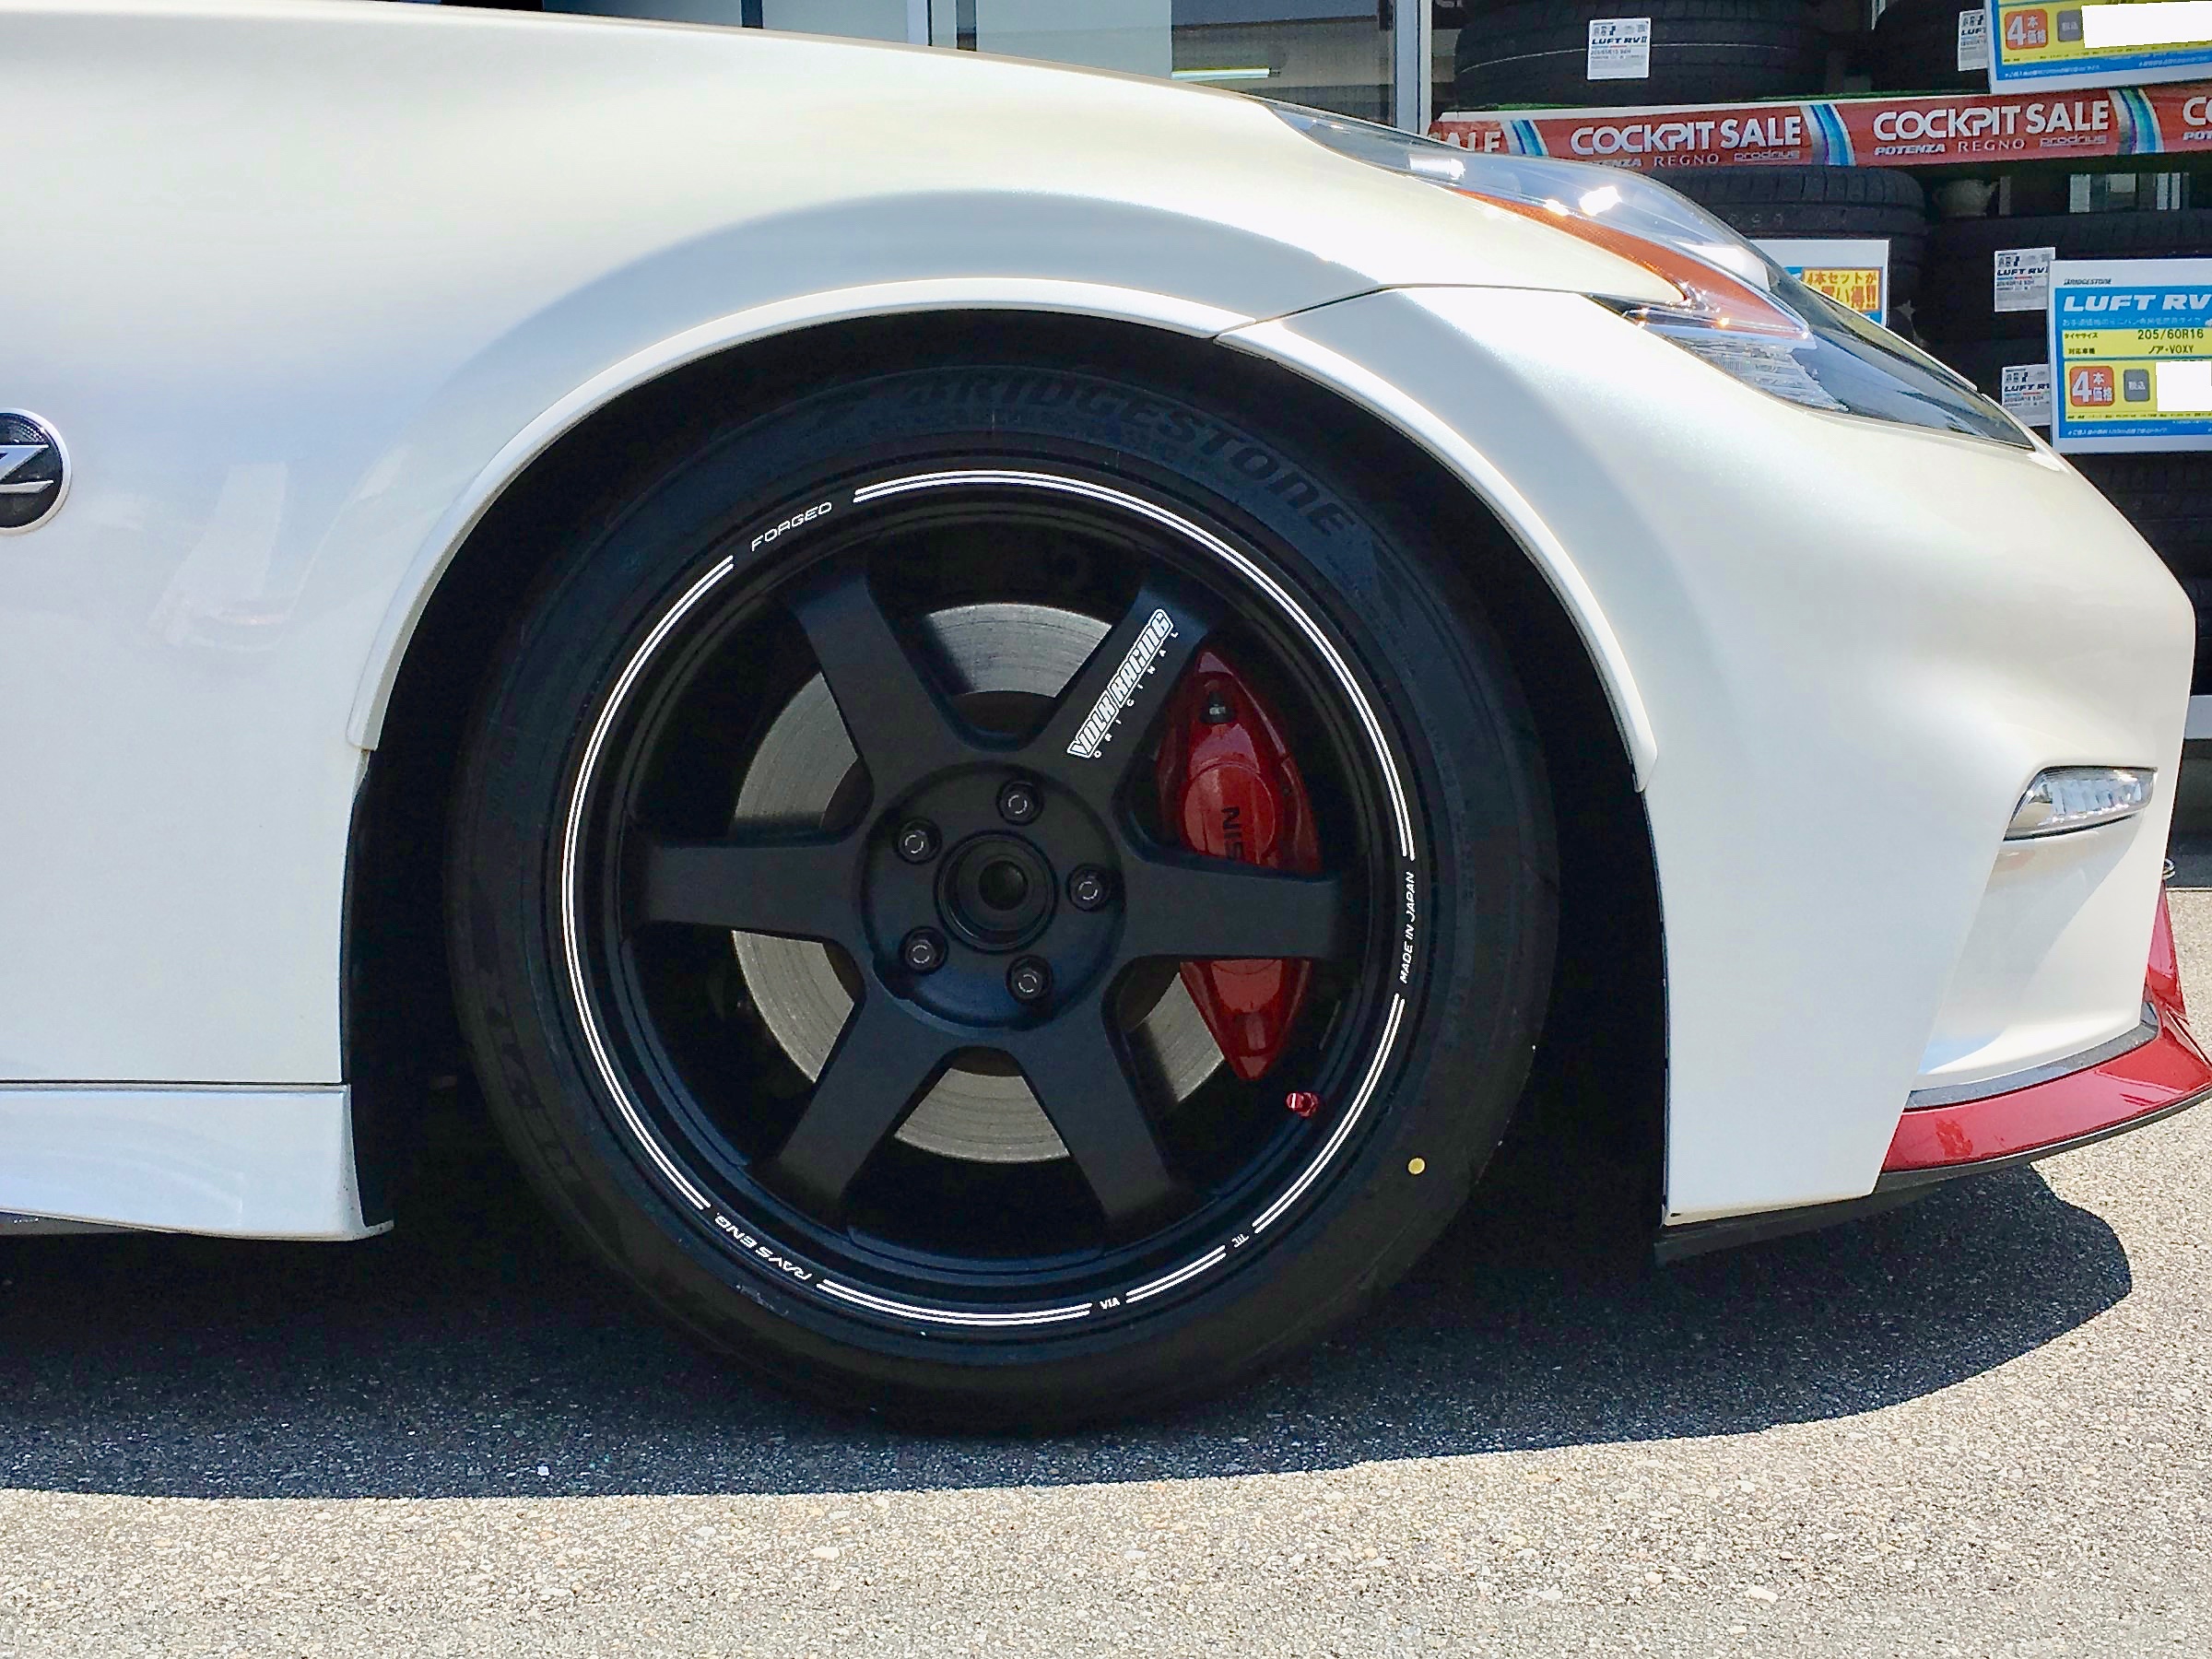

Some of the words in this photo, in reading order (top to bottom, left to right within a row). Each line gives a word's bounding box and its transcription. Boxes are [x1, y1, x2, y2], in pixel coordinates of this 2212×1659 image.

[1873, 104, 2022, 141] COCKPIT
[2025, 100, 2110, 135] SALE
[1571, 121, 1716, 156] COCKPIT
[1719, 115, 1802, 149] SALE
[1873, 142, 1946, 156] POTENZA
[1957, 138, 2026, 153] REGNO
[1653, 152, 1720, 168] REGNO
[1996, 268, 2026, 276] LUFT
[2063, 294, 2157, 312] LUFT
[2137, 328, 2204, 340] 205/60R16
[2004, 383, 2035, 392] LUFT
[750, 501, 832, 552] FORGED
[1093, 631, 1179, 759] ORIGINAL
[1067, 690, 1119, 758] VOLK
[1406, 871, 1416, 923] JAPAN
[1405, 924, 1415, 940] IN
[1399, 940, 1414, 984] MADE
[755, 1246, 813, 1280] RAYS
[1099, 1297, 1121, 1311] VIA
